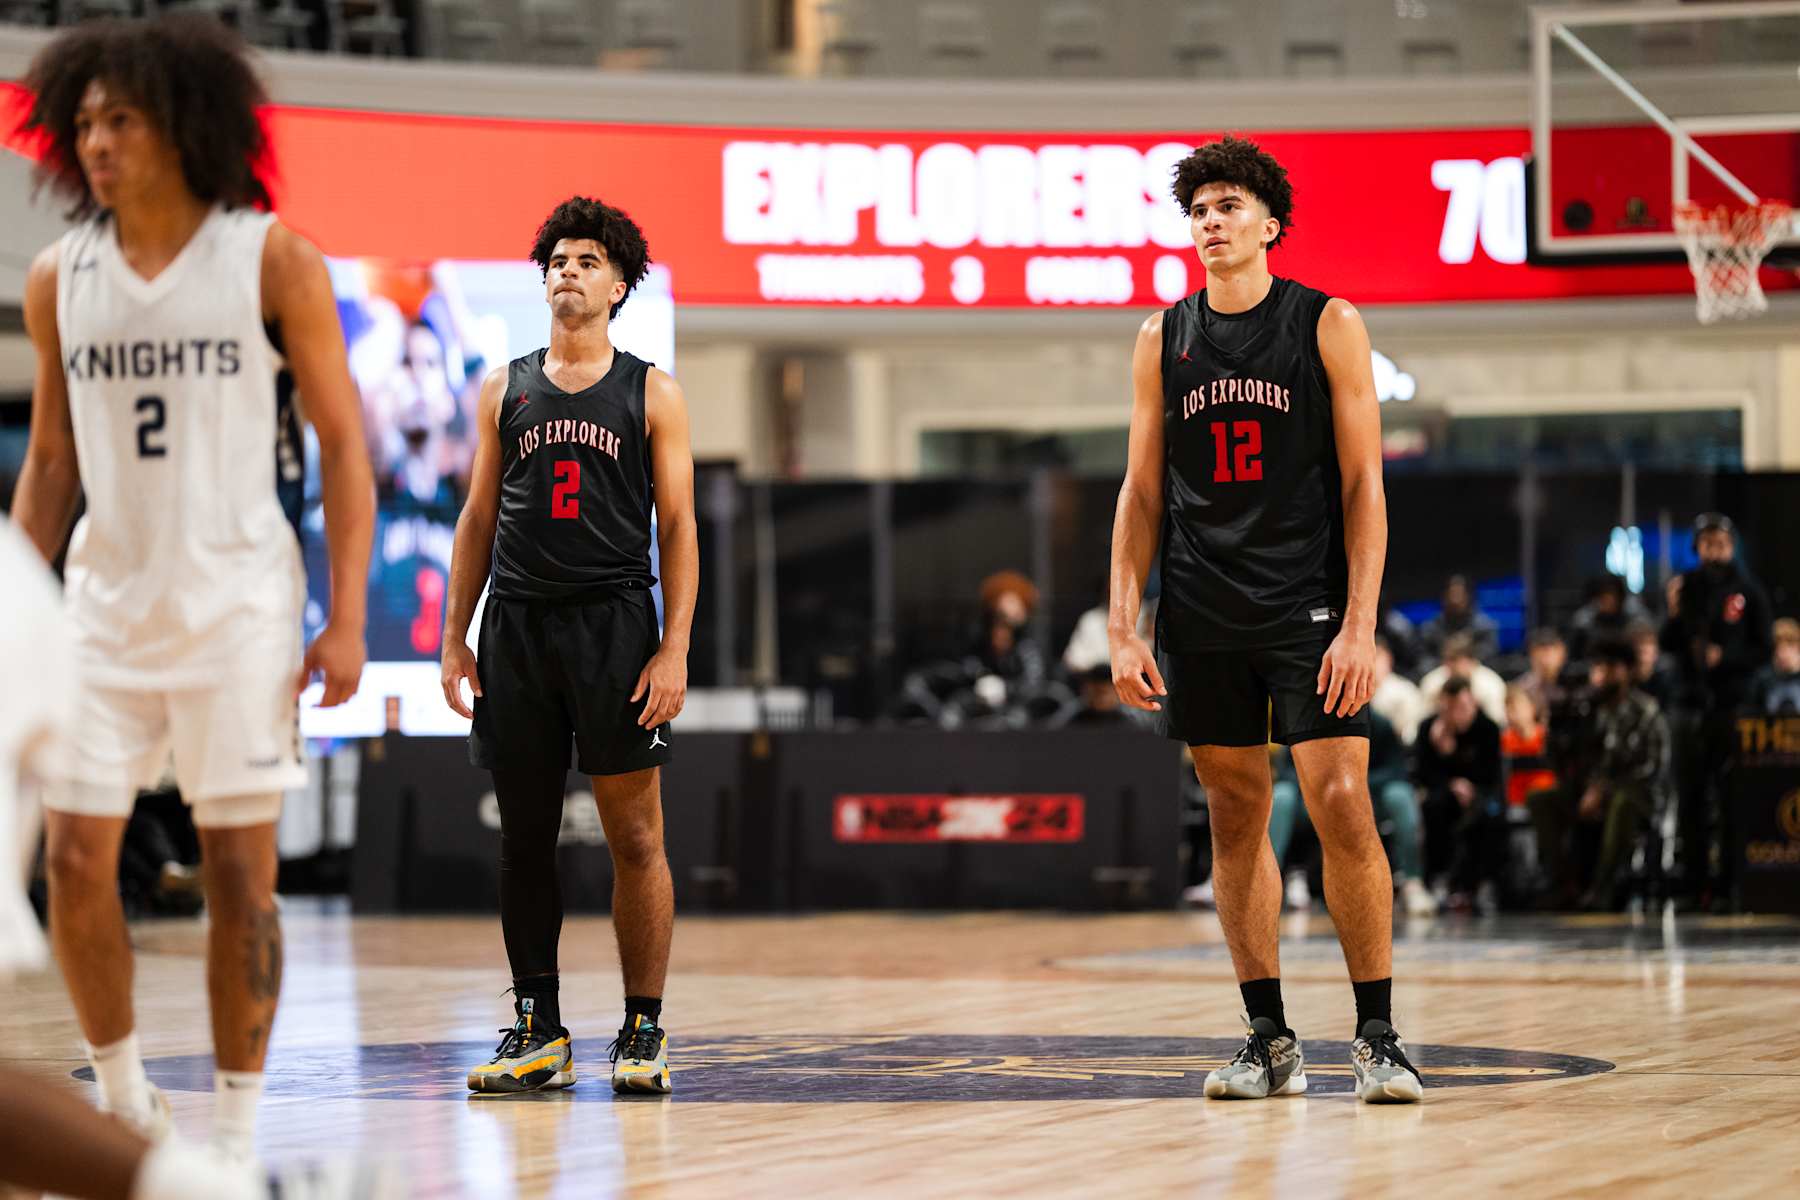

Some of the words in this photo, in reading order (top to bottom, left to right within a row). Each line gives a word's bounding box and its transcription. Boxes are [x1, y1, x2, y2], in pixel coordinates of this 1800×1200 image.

[724, 143, 1196, 247] EXPLORERS
[66, 340, 241, 380] KNIGHTS
[134, 394, 168, 460] 2
[1183, 384, 1206, 421] LOS
[1211, 378, 1290, 413] EXPLORERS
[518, 424, 540, 461] LOS
[545, 419, 621, 461] EXPLORERS
[1210, 420, 1263, 483] 12
[551, 460, 581, 519] 2
